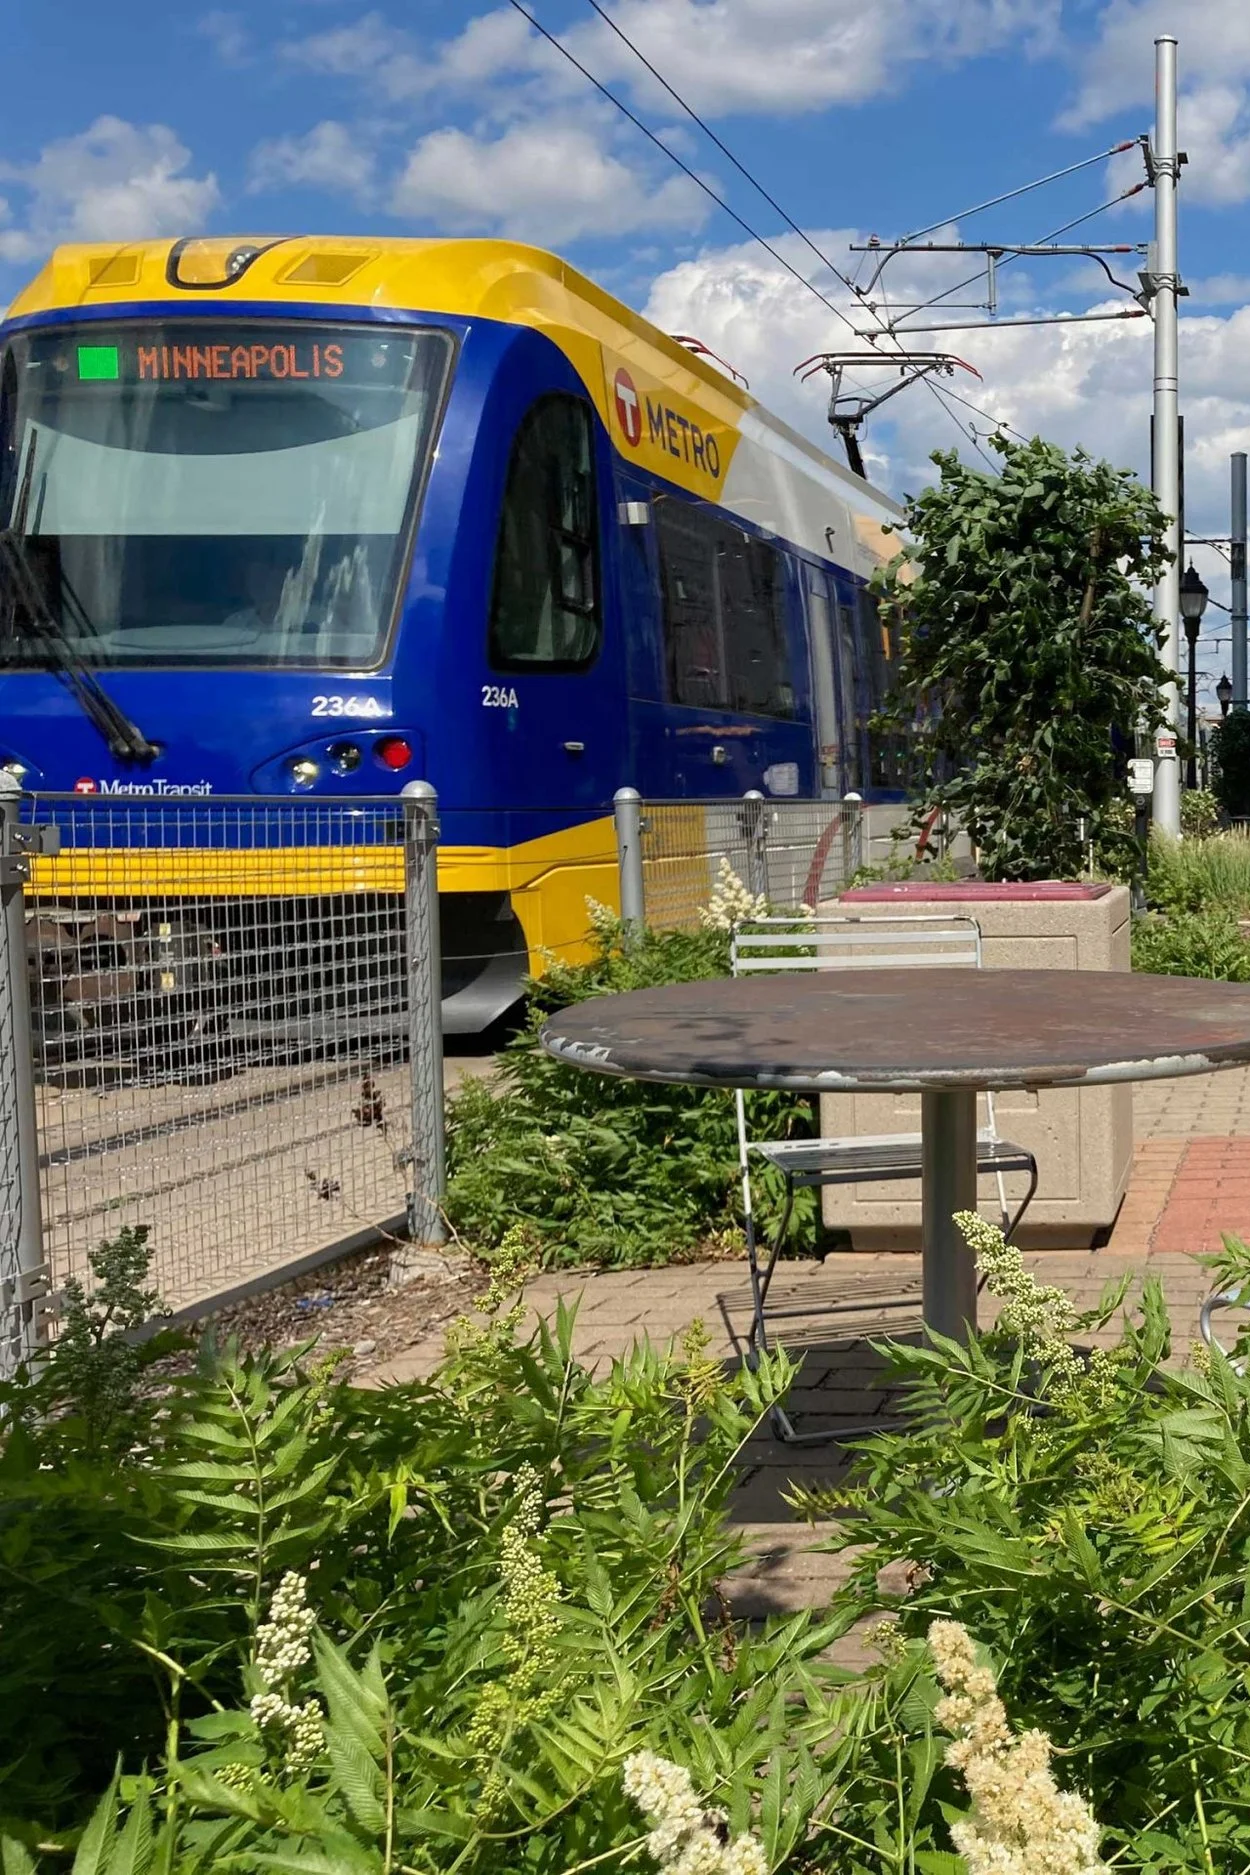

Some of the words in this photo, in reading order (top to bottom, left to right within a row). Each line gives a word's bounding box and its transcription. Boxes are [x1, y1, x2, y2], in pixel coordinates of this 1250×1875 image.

[137, 345, 344, 379] MINNEAPOLIS
[645, 396, 720, 479] METRO
[311, 695, 383, 717] 236A
[482, 685, 519, 709] 236A
